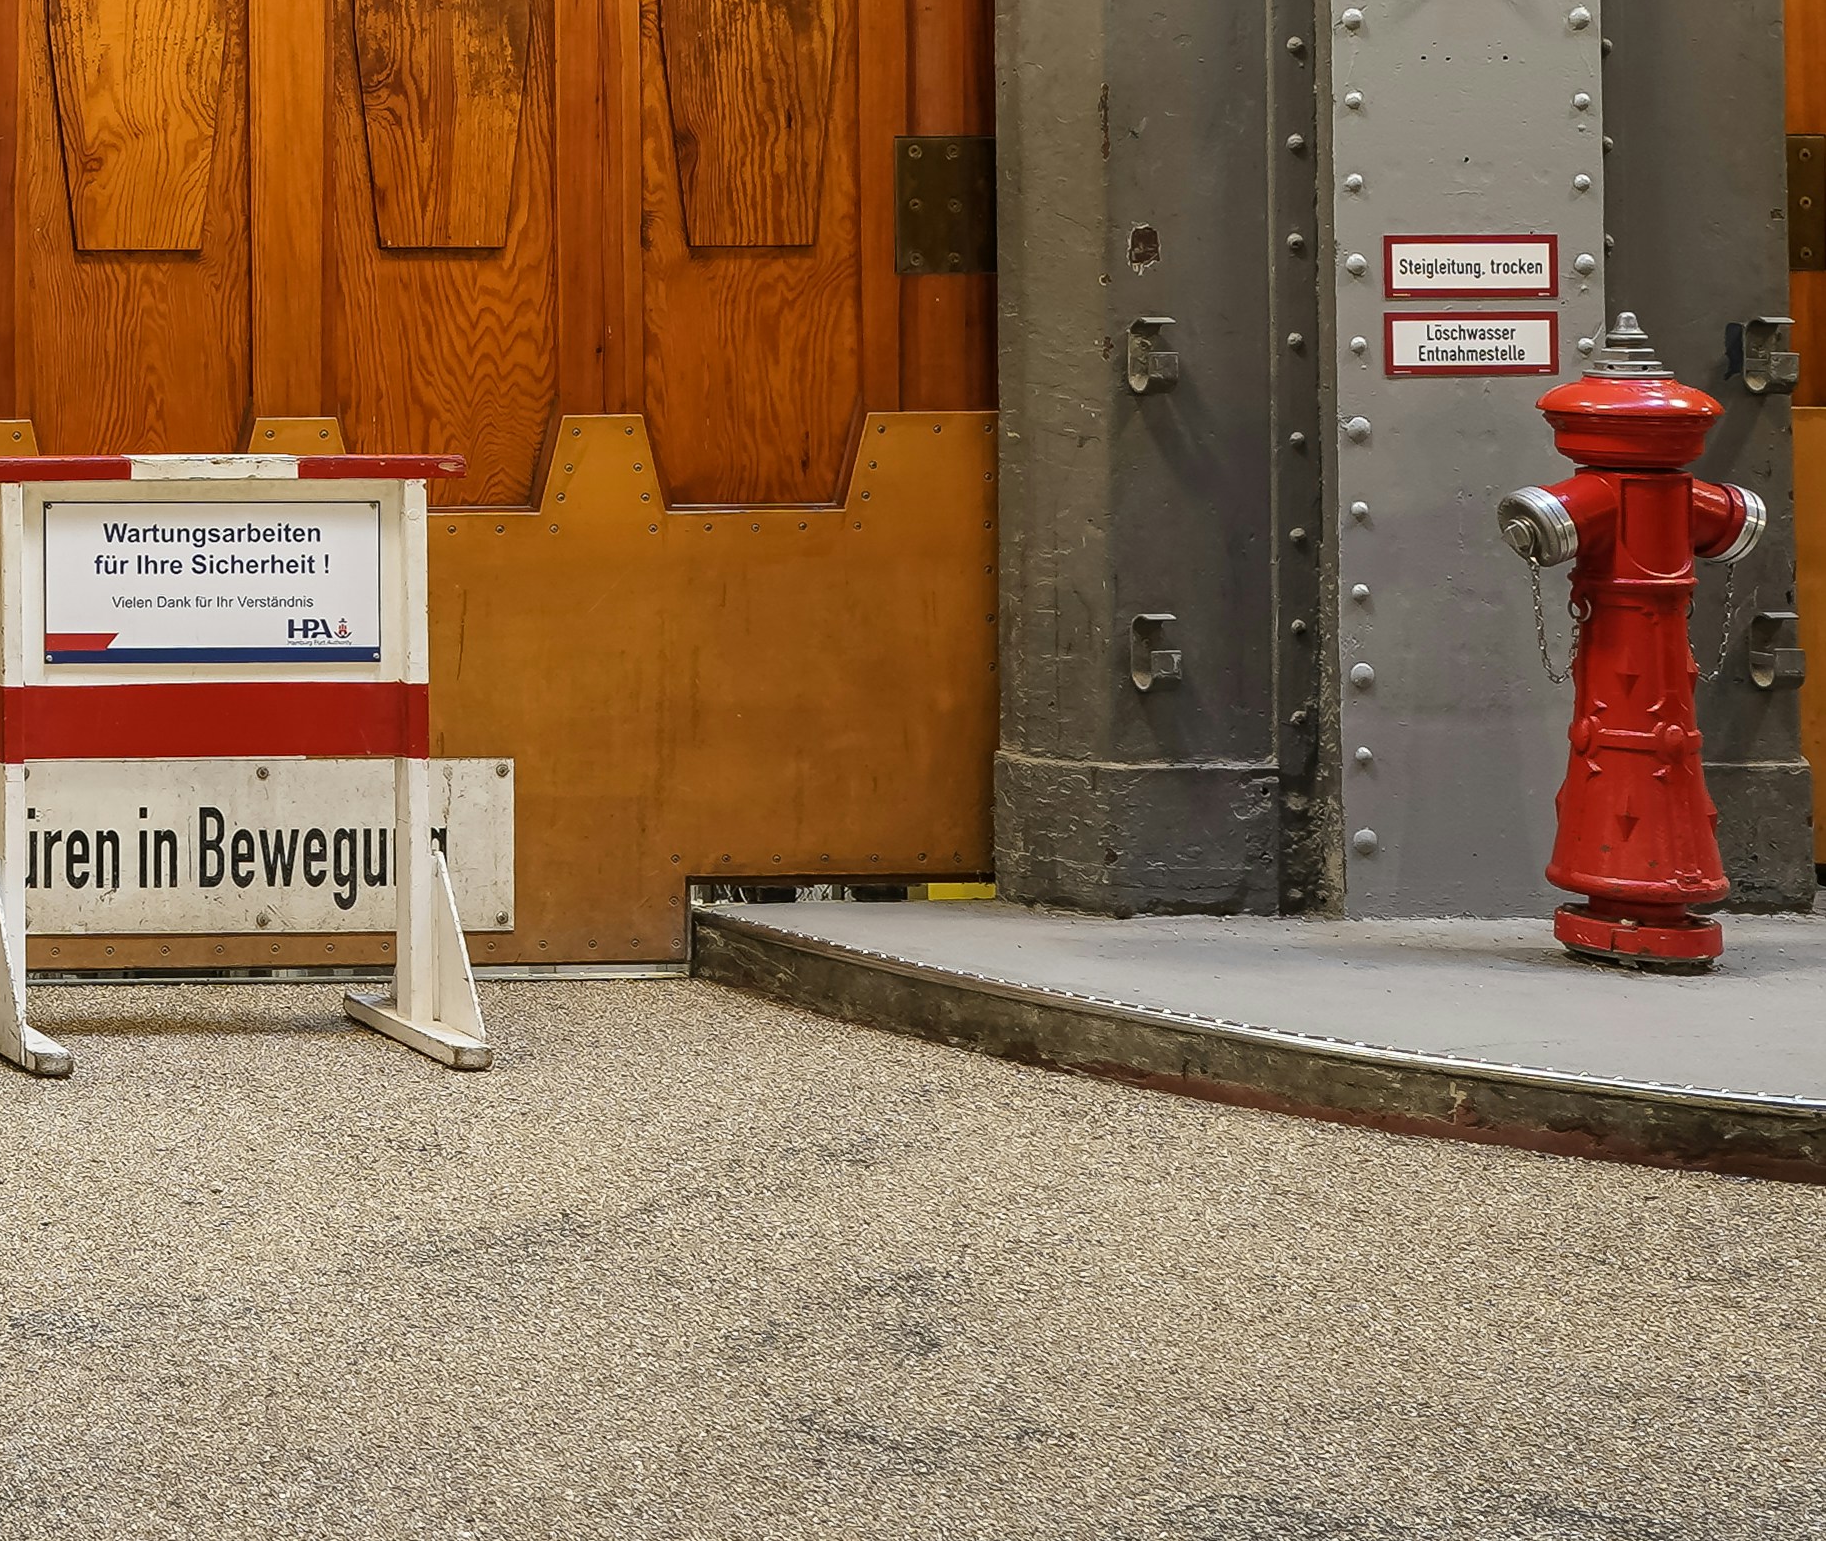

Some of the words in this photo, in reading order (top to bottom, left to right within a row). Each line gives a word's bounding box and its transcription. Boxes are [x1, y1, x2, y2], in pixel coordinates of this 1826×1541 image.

[1490, 259, 1543, 275] trocken
[1426, 324, 1516, 342] Löschwasser
[1418, 345, 1525, 362] Entnahmestelle
[102, 522, 321, 548] Wartungsarbeiten
[93, 554, 130, 575] für
[137, 554, 183, 575] Ihre
[191, 553, 316, 575] Sicherheit
[323, 553, 330, 575] !
[111, 596, 153, 609] Vielen
[156, 596, 192, 609] Dank
[195, 596, 213, 608] für
[216, 596, 234, 608] Ihr
[236, 596, 314, 608] Verständnis
[287, 618, 333, 639] HPA
[139, 807, 178, 889] in
[198, 806, 447, 911] Bewegu
